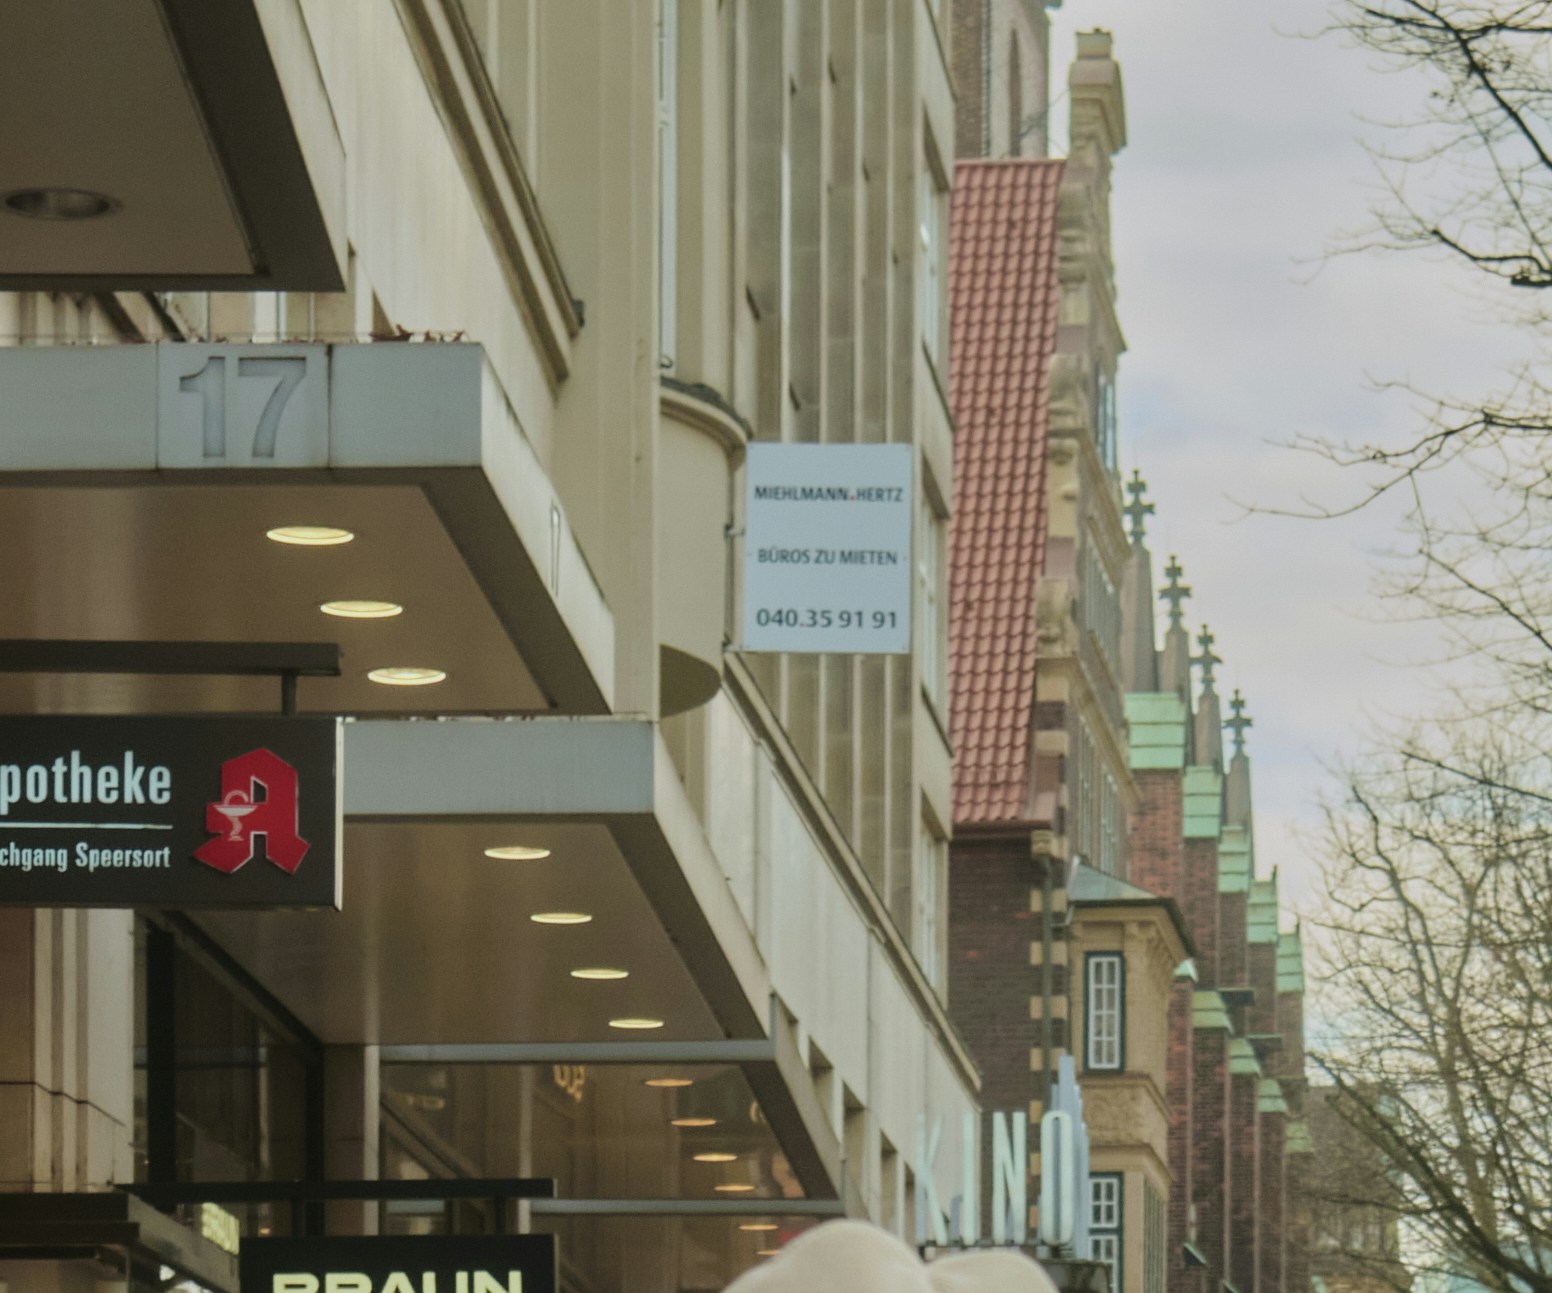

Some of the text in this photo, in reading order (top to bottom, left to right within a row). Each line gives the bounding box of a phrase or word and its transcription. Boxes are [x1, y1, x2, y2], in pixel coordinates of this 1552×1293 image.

[179, 356, 307, 458] 17
[754, 485, 903, 502] MIEHLMANN.HERTZ
[758, 546, 897, 566] BÜROS ZU MIETEN
[756, 608, 896, 630] 040.35 91 91
[0, 750, 171, 816] potheke
[0, 841, 171, 872] chgang Speersort
[915, 1110, 1073, 1245] KINO
